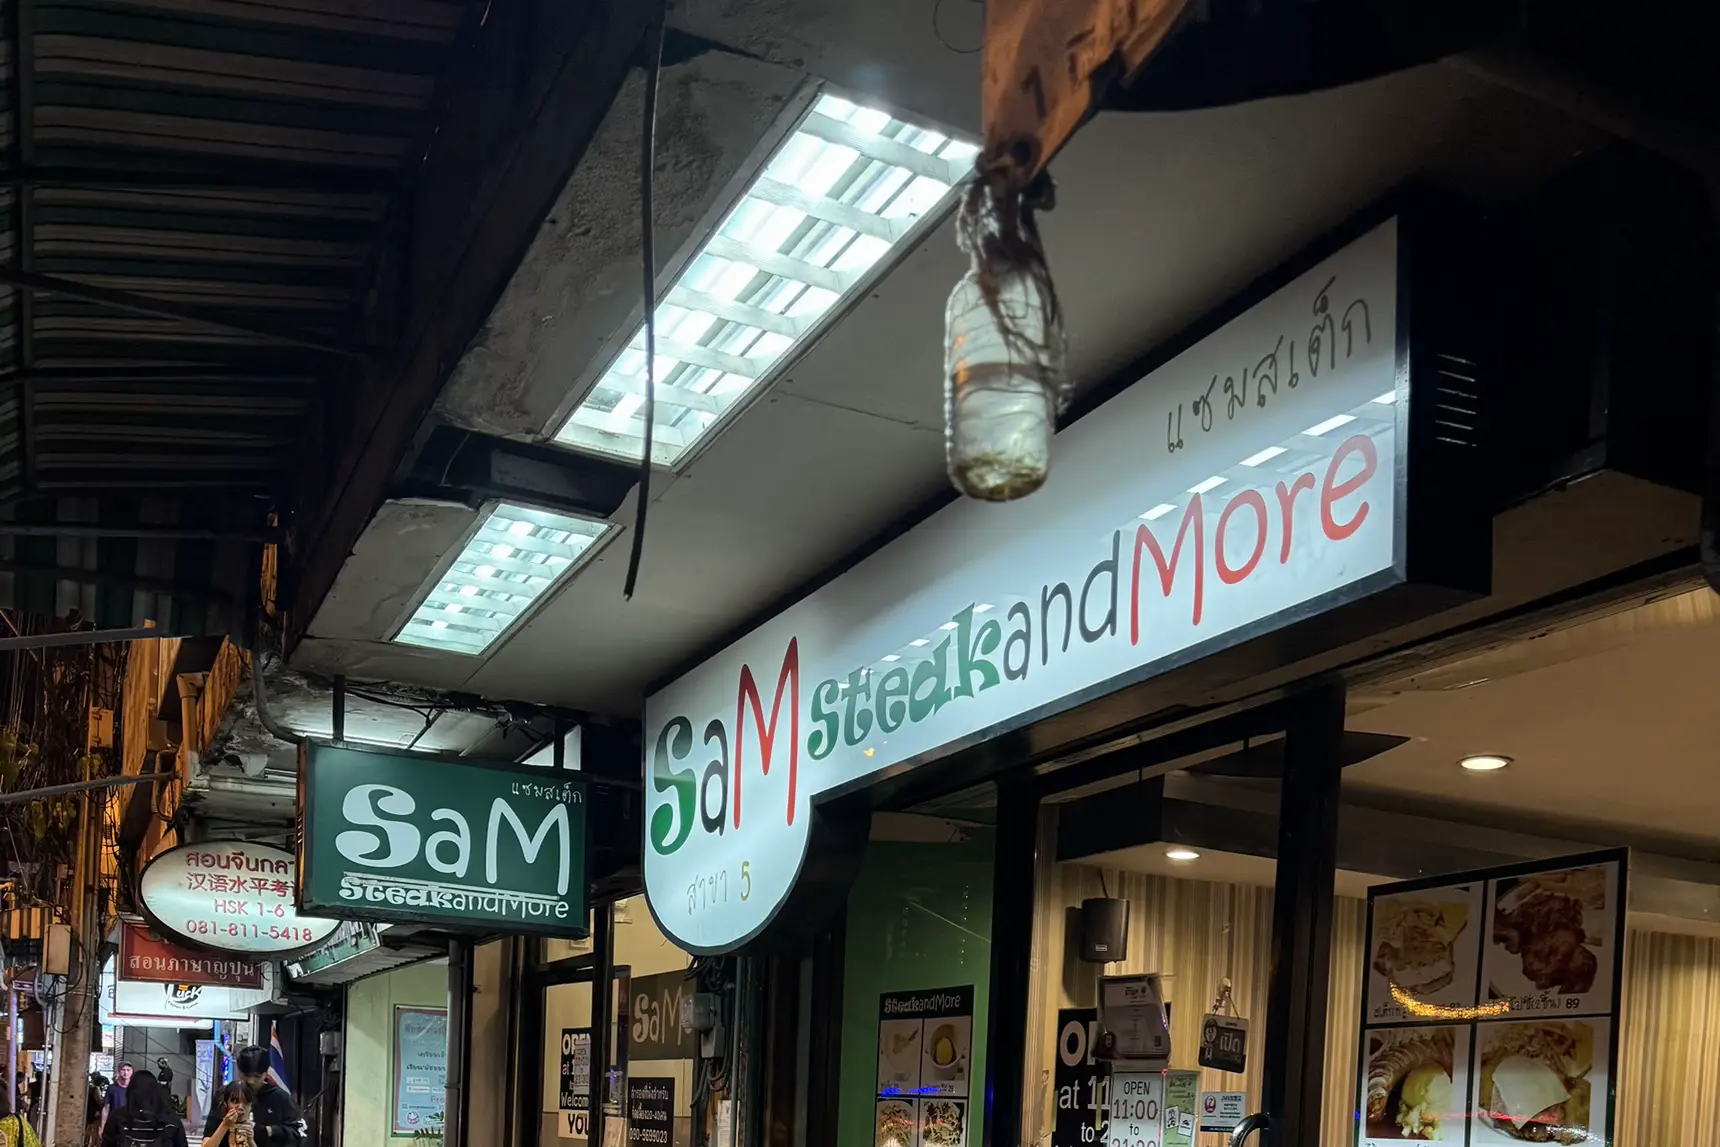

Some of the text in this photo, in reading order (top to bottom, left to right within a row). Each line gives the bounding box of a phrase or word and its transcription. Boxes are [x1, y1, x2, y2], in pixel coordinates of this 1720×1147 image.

[1167, 275, 1372, 453] แซมสเต็ก
[650, 636, 800, 856] SaM
[511, 781, 583, 804] แซมสเต็ก
[335, 783, 571, 896] SaM
[186, 872, 296, 899] 汉语水平考
[686, 860, 751, 916] สาขา 5
[213, 898, 285, 918] HSK 1-6
[185, 919, 313, 943] 081-811-5418
[1565, 998, 1580, 1009] 89
[560, 1091, 589, 1108] Welcom
[1058, 1078, 1080, 1110] at
[1123, 1081, 1151, 1096] OPEN
[1113, 1099, 1158, 1121] 11:00
[1080, 1121, 1096, 1144] to
[1129, 1123, 1140, 1136] to
